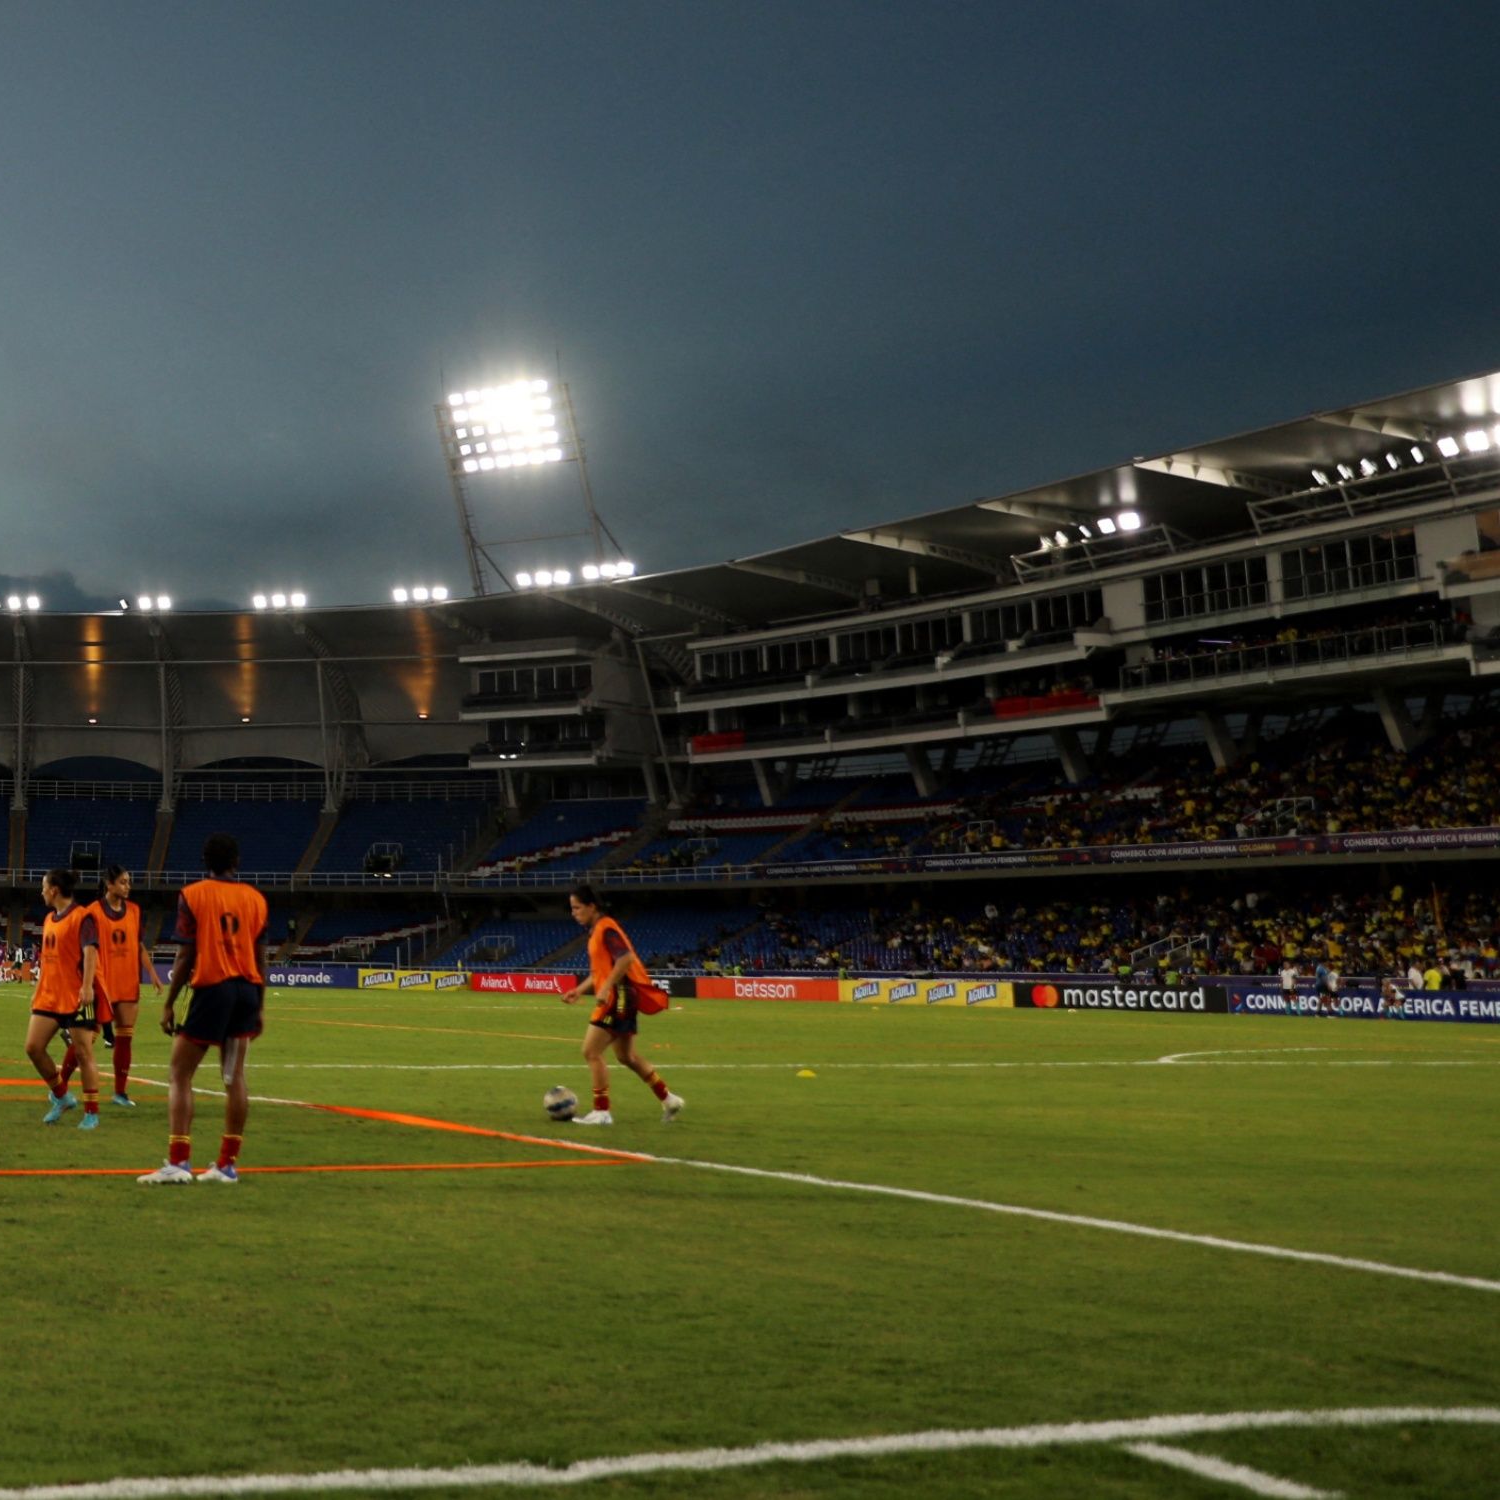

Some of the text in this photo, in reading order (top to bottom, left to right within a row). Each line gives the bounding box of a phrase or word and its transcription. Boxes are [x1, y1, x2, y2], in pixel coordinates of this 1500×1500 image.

[1343, 837, 1389, 847] CONMEBOL
[1391, 836, 1415, 845] COPA
[269, 971, 331, 986] en grande
[363, 972, 393, 987] AGUILA
[400, 973, 430, 988] AGUILA
[436, 974, 466, 989] AGUILA
[480, 975, 508, 989] Avianca
[524, 976, 554, 990] Avianca
[734, 979, 796, 998] betsson
[853, 981, 879, 1001] AGUILA
[890, 982, 916, 1001] AGUILA
[928, 983, 956, 1003] AGUILA
[967, 984, 996, 1005] AGUILA
[1063, 985, 1205, 1010] mastercard
[1330, 996, 1375, 1013] COPA
